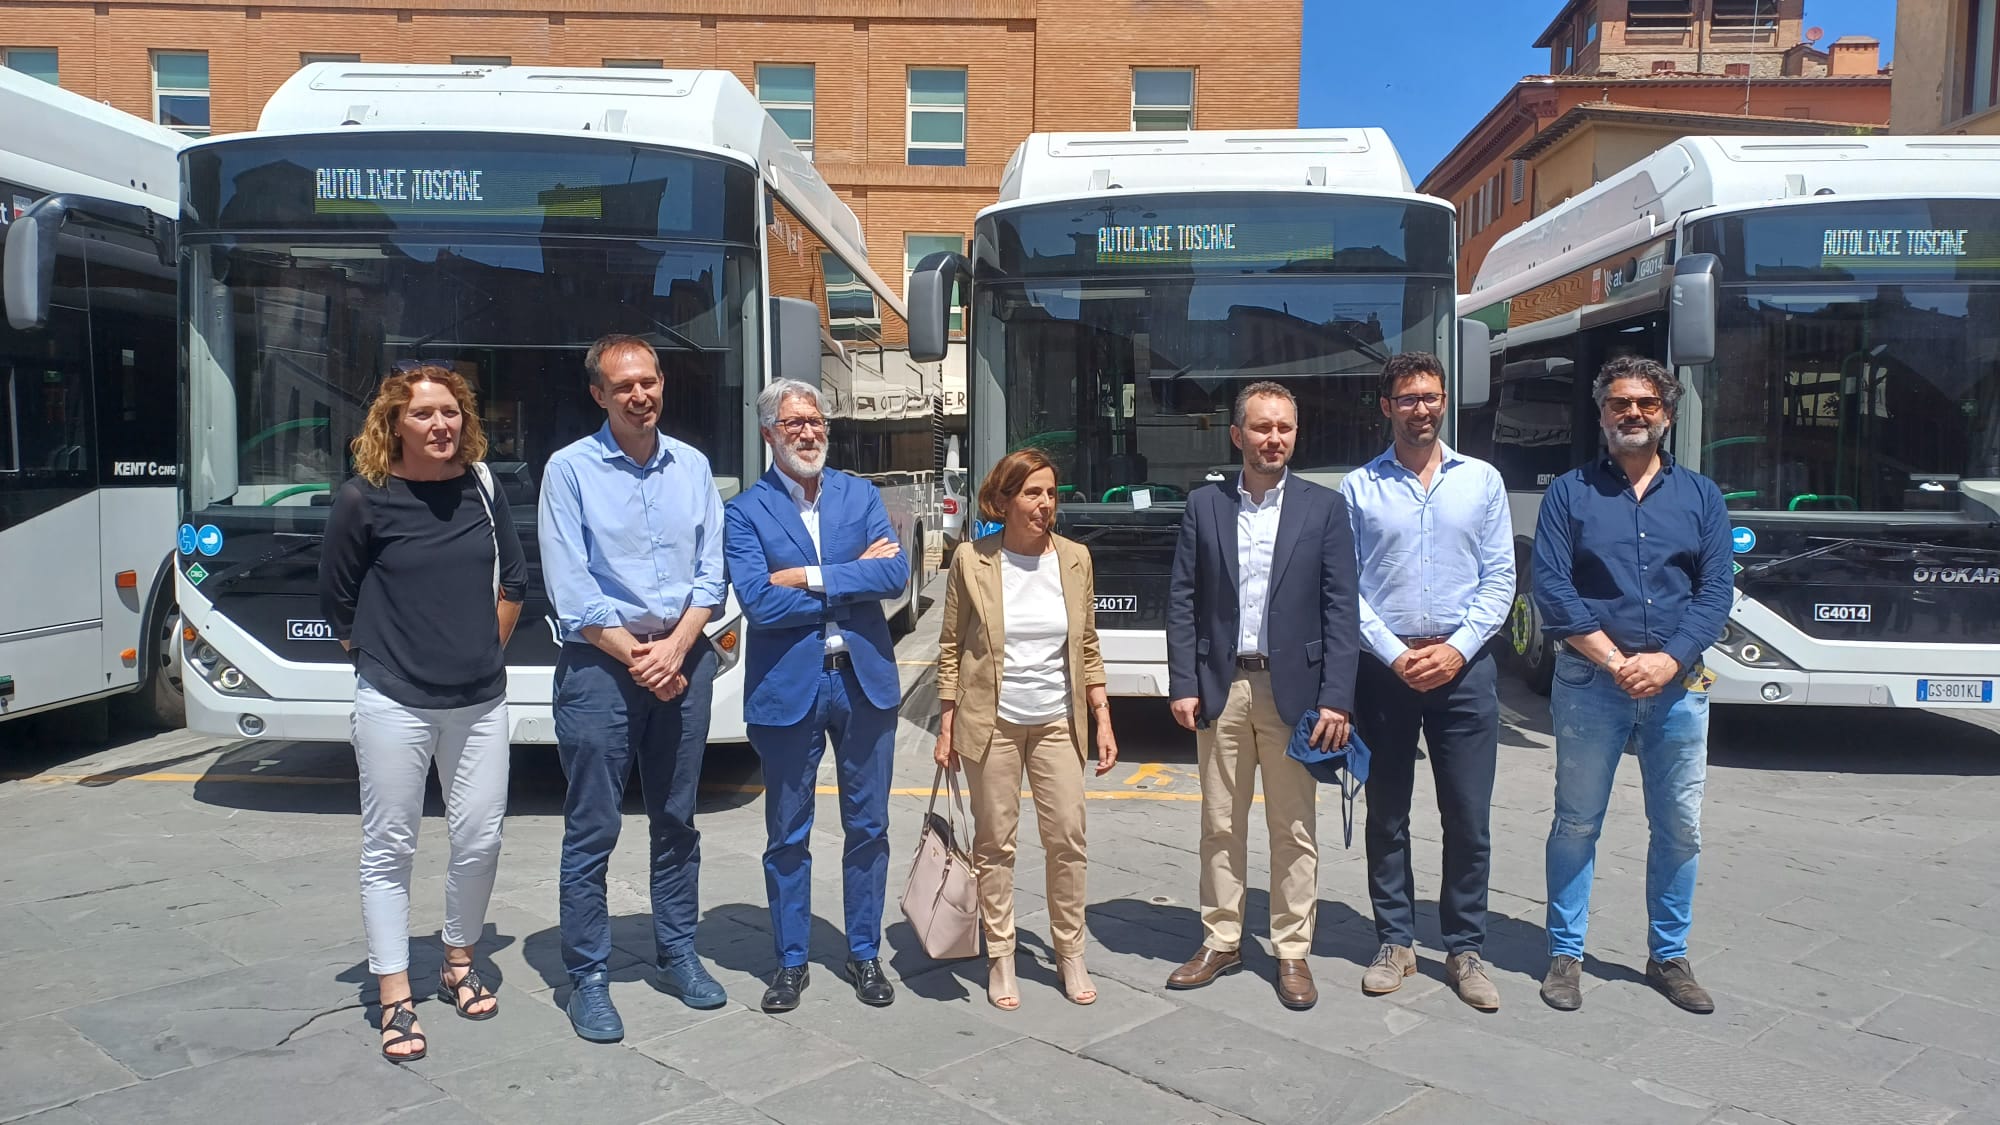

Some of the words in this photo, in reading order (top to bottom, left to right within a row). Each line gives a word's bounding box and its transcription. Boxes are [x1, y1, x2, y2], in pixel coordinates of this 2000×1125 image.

[315, 168, 408, 200] AUTOLINEE
[412, 169, 484, 201] TOSCANE
[1098, 225, 1173, 253] AUTOLINEE
[1177, 223, 1236, 250] TOSCANE
[1823, 229, 1902, 256] AUTOLINEE
[1906, 229, 1968, 256] TOSCANE
[1640, 256, 1663, 277] G4014
[1613, 268, 1623, 288] at
[113, 461, 148, 476] KENT
[147, 461, 158, 476] C
[158, 465, 177, 476] CNG
[1912, 567, 2000, 584] OTOKAR
[1818, 606, 1868, 620] G4014
[291, 622, 332, 638] G401
